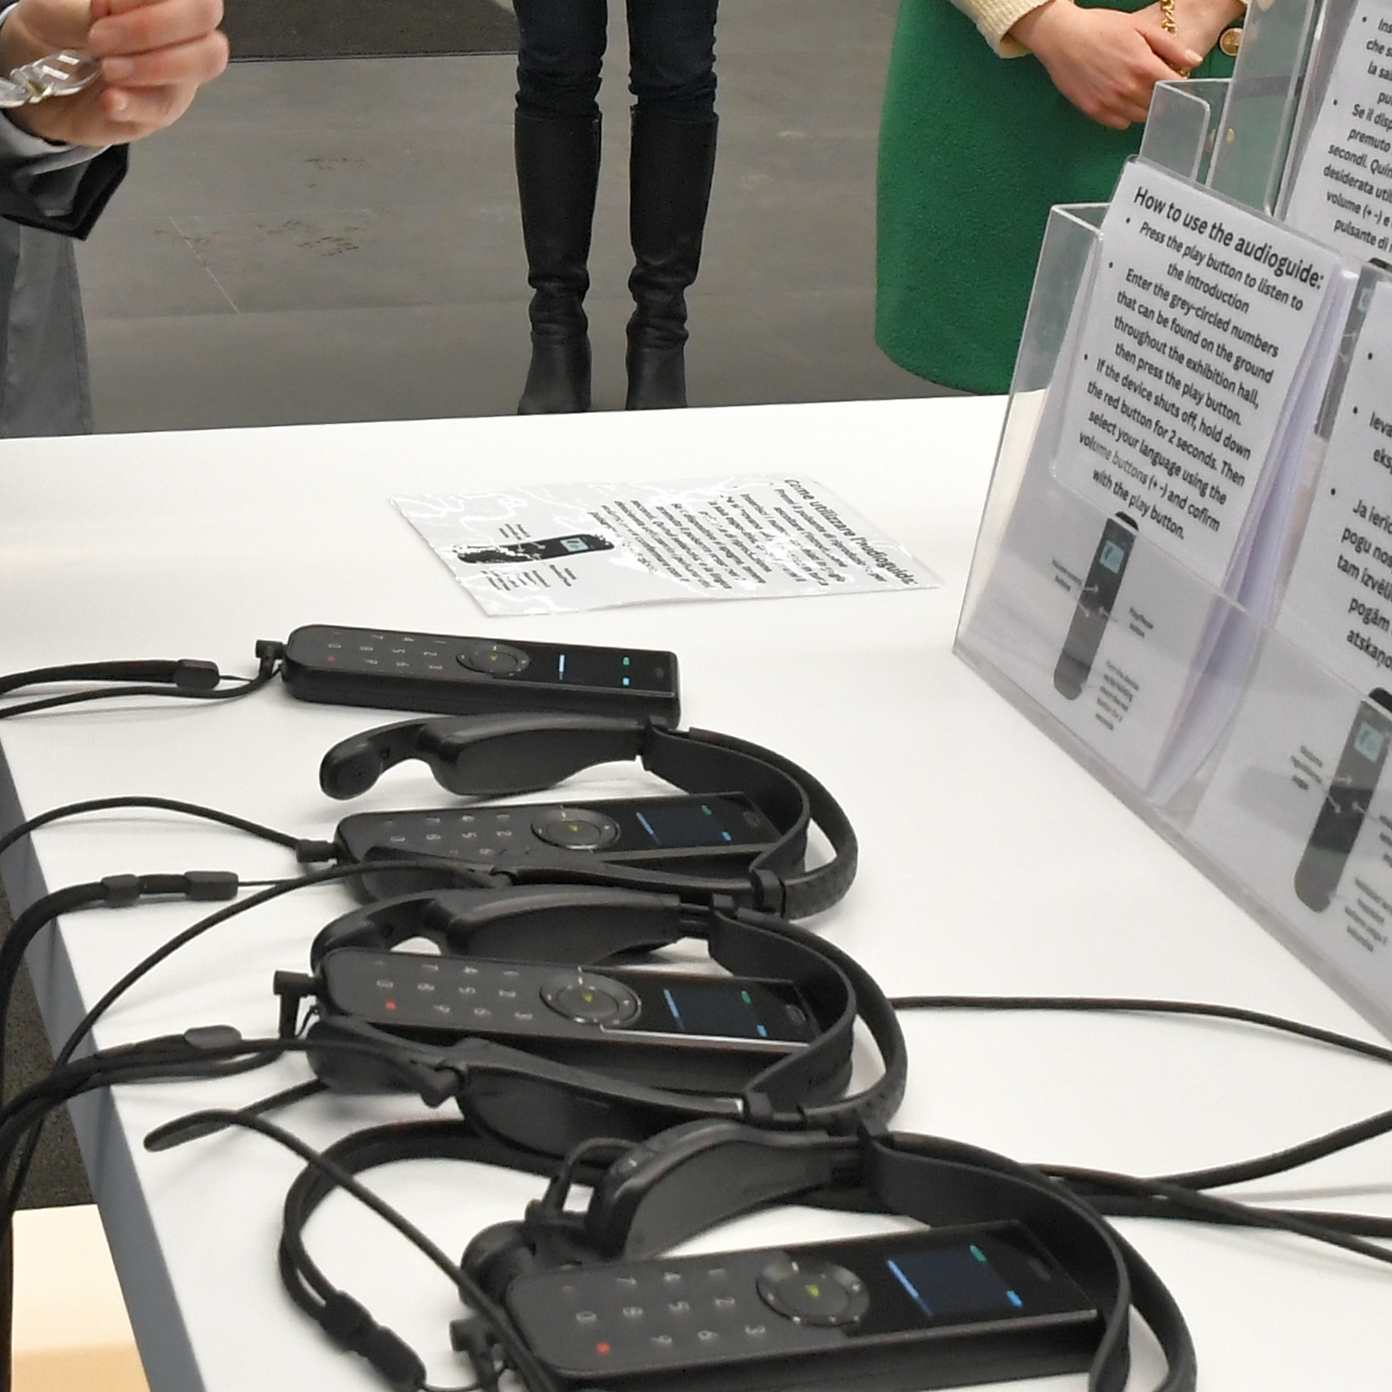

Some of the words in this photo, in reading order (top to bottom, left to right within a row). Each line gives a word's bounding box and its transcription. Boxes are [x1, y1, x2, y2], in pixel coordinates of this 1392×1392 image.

[1366, 39, 1385, 55] che
[1367, 61, 1378, 75] la
[1347, 129, 1391, 153] premuto
[1352, 103, 1365, 119] Se
[1365, 108, 1374, 122] il
[1134, 186, 1166, 214] How
[1166, 202, 1182, 222] to
[1182, 213, 1208, 235] use
[1208, 222, 1234, 247] the
[1234, 237, 1324, 290] audioguide:
[1139, 221, 1166, 244] Press
[1166, 235, 1183, 253] the
[1181, 245, 1207, 267] play
[1206, 253, 1243, 282] button
[1244, 273, 1257, 288] to
[1257, 278, 1289, 304] listen
[1290, 295, 1303, 311] to
[1125, 268, 1153, 291] Enter
[1153, 283, 1170, 301] the
[1169, 294, 1231, 333] grey-circled
[1230, 325, 1279, 358] numbers
[1167, 263, 1184, 281] the
[1185, 270, 1250, 314] introduction
[1114, 316, 1167, 355] throughout
[1168, 346, 1185, 365] the
[1186, 358, 1236, 393] exhibition
[1237, 382, 1259, 410] hall,
[1117, 291, 1137, 311] that
[1137, 304, 1155, 321] can
[1156, 310, 1169, 328] be
[1170, 317, 1201, 345] found
[1200, 338, 1215, 353] on
[1215, 343, 1233, 363] the
[1233, 355, 1274, 384] ground
[1096, 358, 1106, 373] If
[1105, 364, 1120, 383] the
[1121, 374, 1153, 402] device
[1153, 393, 1180, 418] shuts
[1181, 411, 1198, 431] off,
[1198, 417, 1224, 443] hold
[1223, 434, 1251, 460] down
[1115, 343, 1137, 365] then
[1136, 357, 1164, 380] press
[1165, 371, 1181, 390] the
[1181, 383, 1205, 406] play
[1205, 392, 1241, 426] button.
[1087, 381, 1103, 400] the
[1103, 393, 1121, 410] red
[1120, 399, 1153, 430] button
[1153, 419, 1169, 439] for
[1168, 429, 1177, 445] 2
[1176, 437, 1217, 471] seconds.
[1220, 460, 1245, 487] Then
[1088, 411, 1117, 436] select
[1115, 428, 1140, 449] your
[1139, 439, 1182, 477] language
[1182, 470, 1209, 498] using
[1209, 485, 1227, 505] the
[1092, 469, 1113, 490] with
[1113, 481, 1129, 501] the
[1128, 495, 1151, 518] play
[1150, 505, 1184, 540] button.
[1341, 527, 1372, 554] pogu
[1352, 500, 1368, 519] Ja
